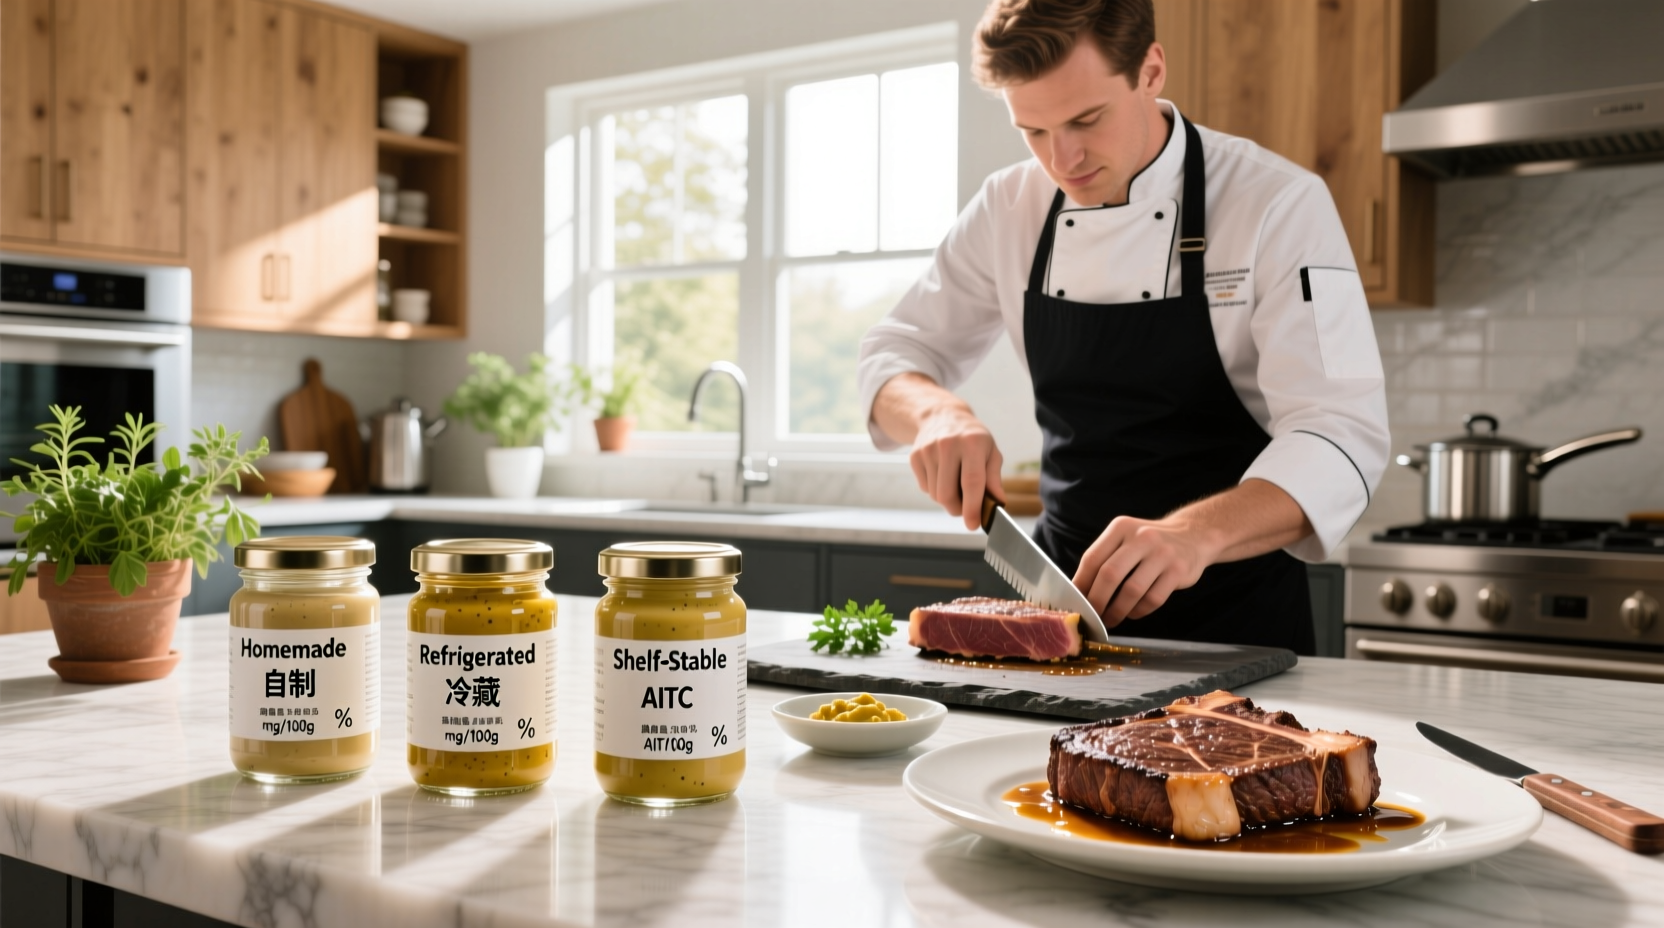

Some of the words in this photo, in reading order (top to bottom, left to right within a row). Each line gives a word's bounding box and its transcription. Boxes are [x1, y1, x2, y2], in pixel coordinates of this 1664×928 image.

[241, 637, 347, 659] Homemade
[420, 642, 536, 672] Refrigerated
[613, 647, 727, 672] Shelf-Stable
[265, 668, 316, 698] 自制
[445, 676, 501, 707] 冷藏
[640, 685, 694, 709] AITC
[262, 718, 315, 736] mg/100g
[334, 707, 353, 729] %
[517, 717, 536, 740] %
[444, 728, 499, 746] mg/100g
[711, 724, 728, 748] %
